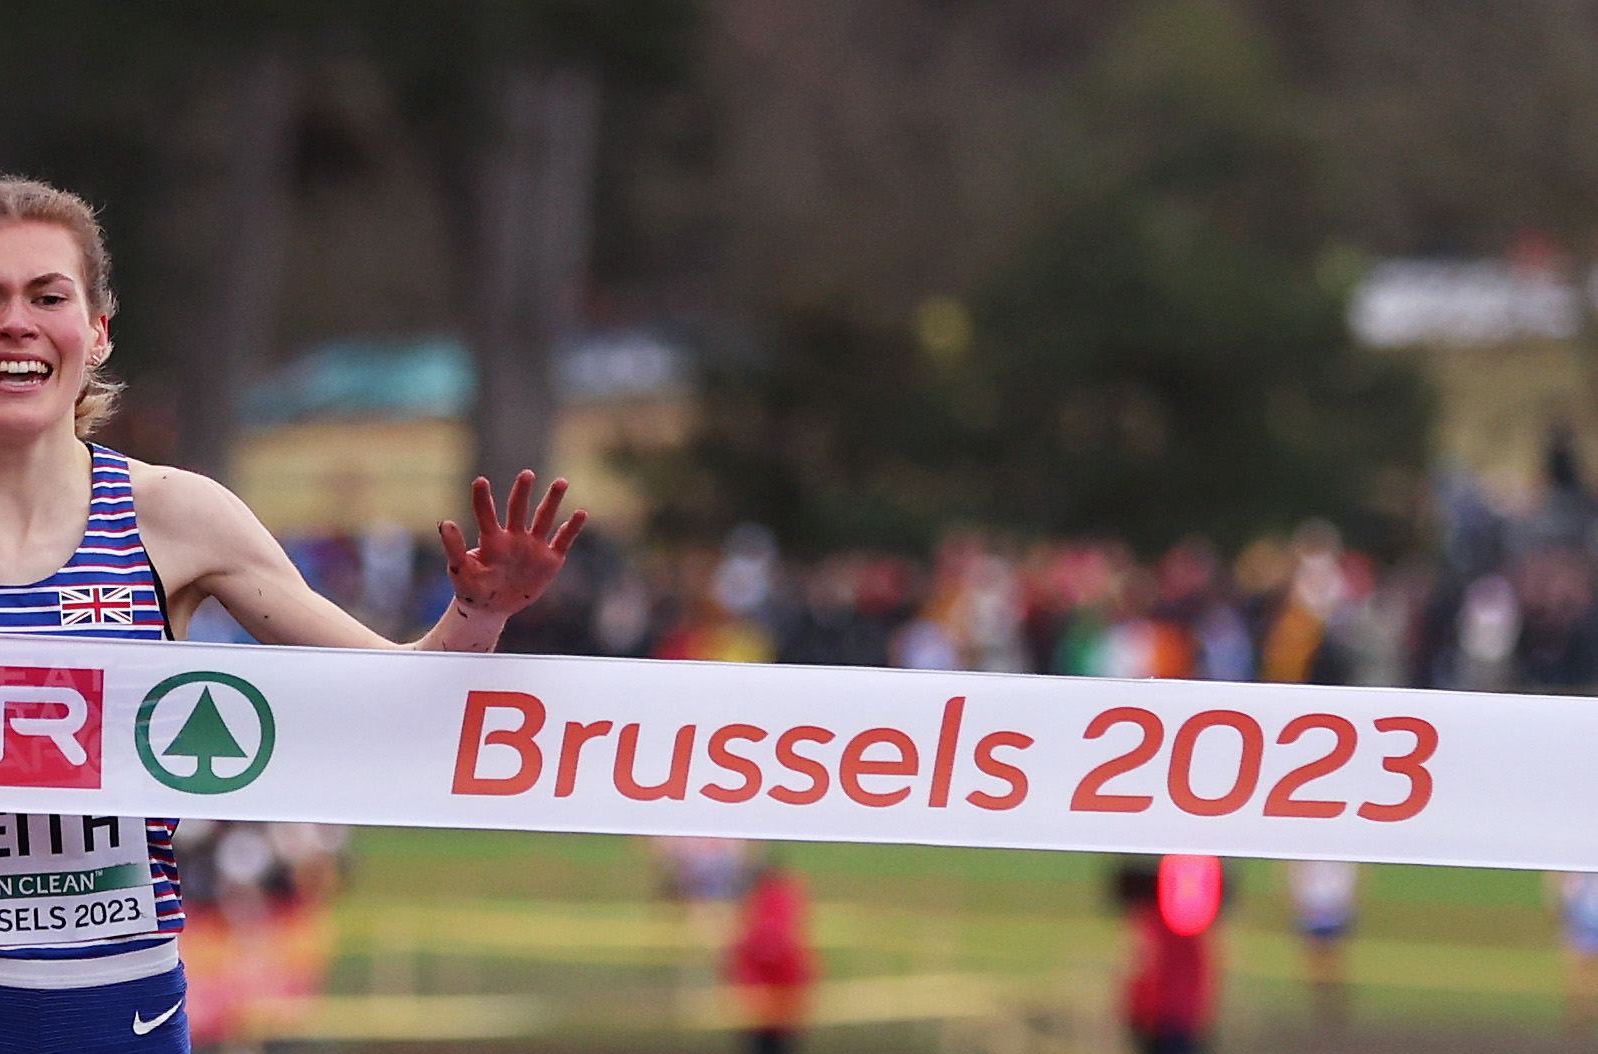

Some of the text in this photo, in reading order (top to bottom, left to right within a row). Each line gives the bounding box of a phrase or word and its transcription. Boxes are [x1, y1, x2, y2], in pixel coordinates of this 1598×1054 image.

[451, 690, 1439, 823] Brussels 2023
[74, 897, 141, 930] 2023
